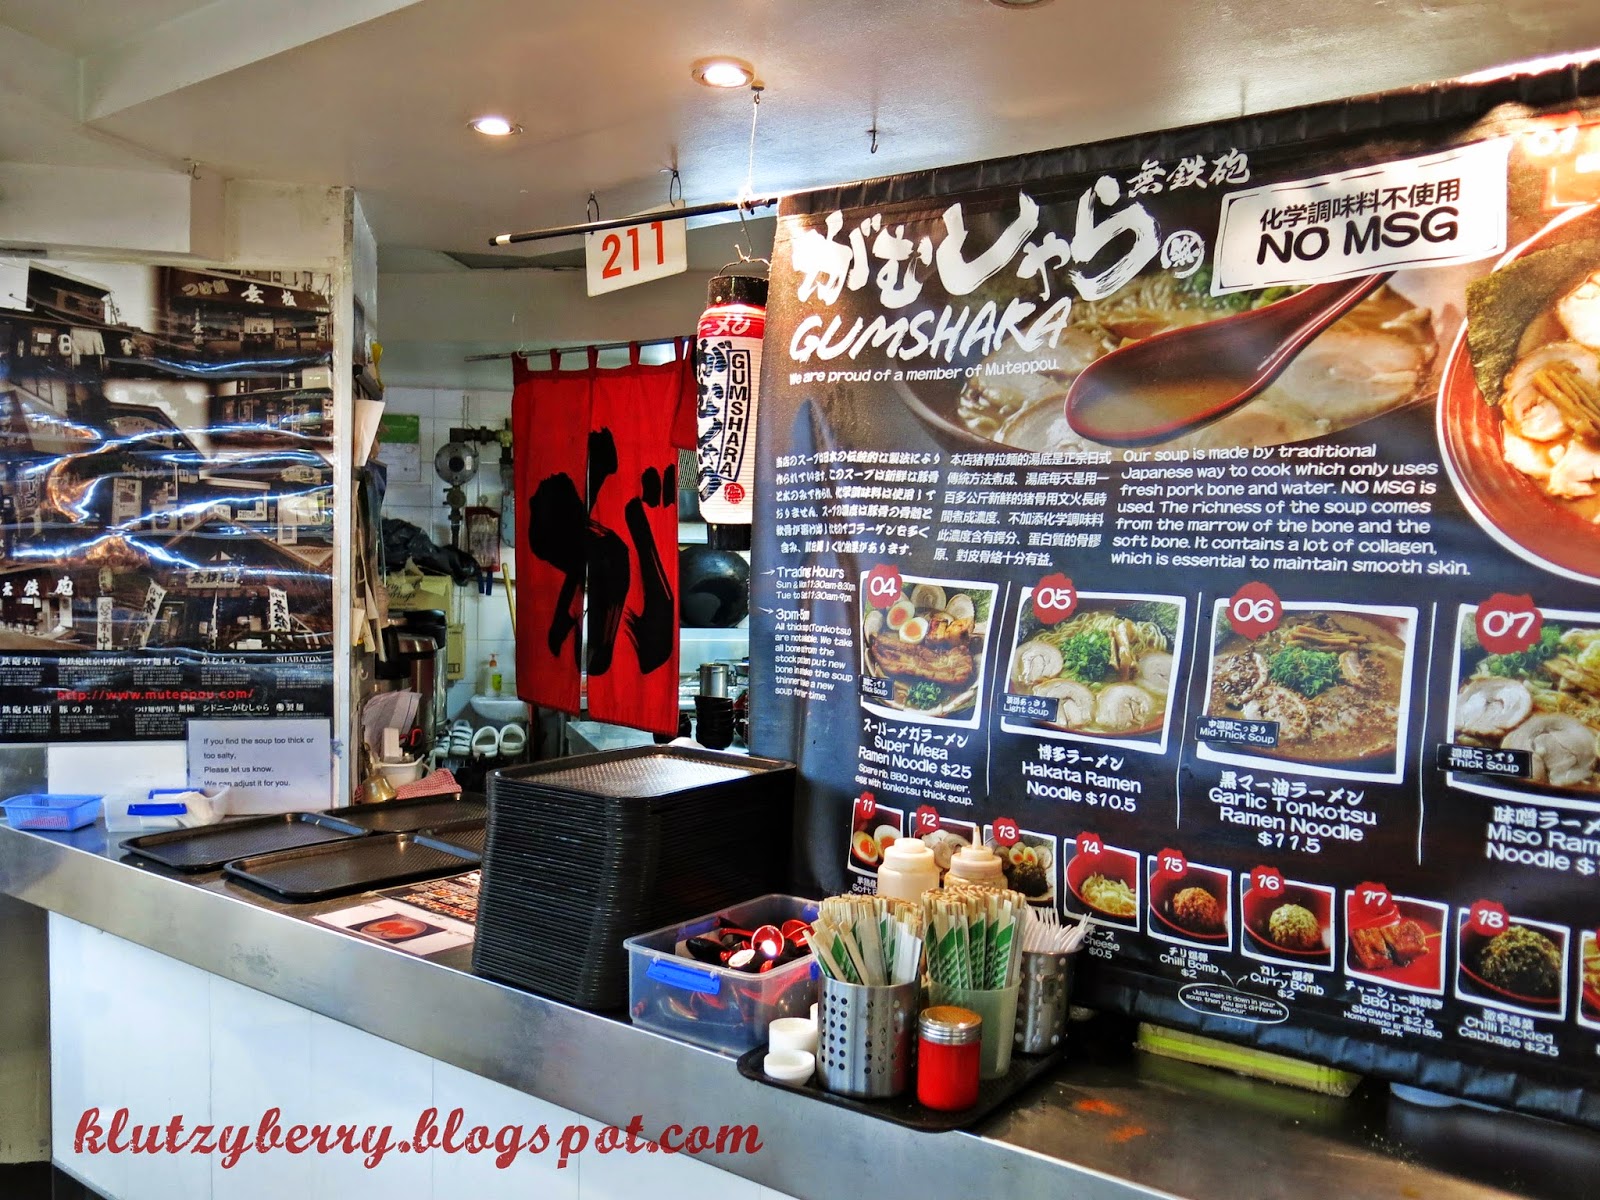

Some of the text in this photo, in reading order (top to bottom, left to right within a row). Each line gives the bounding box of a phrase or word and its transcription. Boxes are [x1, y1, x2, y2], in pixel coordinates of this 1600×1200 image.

[1259, 178, 1460, 232] 化学調味料不使用
[791, 175, 1162, 310] がむしゃら
[1256, 207, 1459, 266] NO MSG
[601, 220, 665, 280] 211
[803, 372, 825, 383] are
[828, 369, 871, 385] proud
[873, 369, 891, 382] of
[894, 370, 904, 381] a
[905, 366, 962, 381] member
[965, 364, 983, 377] of
[719, 353, 748, 478] GUMSHARA
[1123, 443, 1376, 462] Our soup is made by traditional
[1121, 462, 1439, 481] Japanese way to cook which only uses
[1119, 480, 1437, 498] fresh pork bone and water. NO MSG is
[1117, 500, 1432, 516] used. The richness of the soup comes
[1115, 517, 1431, 534] from the marrow of the bone and the
[1112, 534, 1437, 555] soft bone. It contains a lot of collagen,
[812, 565, 845, 579] Hours
[1111, 552, 1471, 575] which is essential to maintain smooth skin.
[776, 581, 792, 589] Sun
[869, 576, 898, 596] 04
[1036, 587, 1072, 610] 05
[1233, 598, 1274, 623] 06
[1483, 610, 1536, 639] 07
[1003, 703, 1049, 717] Light Soup
[254, 738, 272, 746] soup
[1200, 727, 1275, 744] Mid-Thick Soup
[874, 735, 948, 760] Super Mega
[1037, 743, 1124, 771] 博多ラーメン
[858, 745, 972, 779] Ramen Noodle $25
[1448, 757, 1520, 774] Thick Soup
[234, 779, 291, 788] adjust for you.
[1021, 760, 1142, 794] Hakata Ramen
[882, 781, 974, 806] tonkotsu thick soup.
[1026, 780, 1137, 813] Noodle $10.5
[1219, 770, 1365, 806] 黒マー油ラーメン
[863, 799, 873, 813] 11
[1208, 787, 1377, 826] Garlic Tonkotsu
[921, 812, 936, 827] 12
[1219, 805, 1364, 842] Ramen Noodle
[998, 825, 1016, 840] 13
[1257, 831, 1321, 854] $11.5
[1487, 822, 1542, 846] Miso
[1082, 840, 1100, 855] 14
[1486, 842, 1571, 871] Noodle
[1163, 856, 1183, 873] 15
[1257, 874, 1280, 891] 16
[1362, 890, 1387, 906] 17
[1478, 909, 1504, 928] 18
[1083, 936, 1120, 952] Cheese
[1159, 954, 1219, 974] Chilli Bomb
[1181, 968, 1197, 979] $2
[1250, 972, 1325, 996] Curry Bomb
[1277, 989, 1295, 1000] $2
[1361, 994, 1425, 1017] BBQ pork
[1351, 1004, 1435, 1029] skewer $2.5
[1464, 1016, 1497, 1033] Chilli
[1501, 1024, 1554, 1045] Pickled
[1458, 1026, 1560, 1057] Cabbage $2.5
